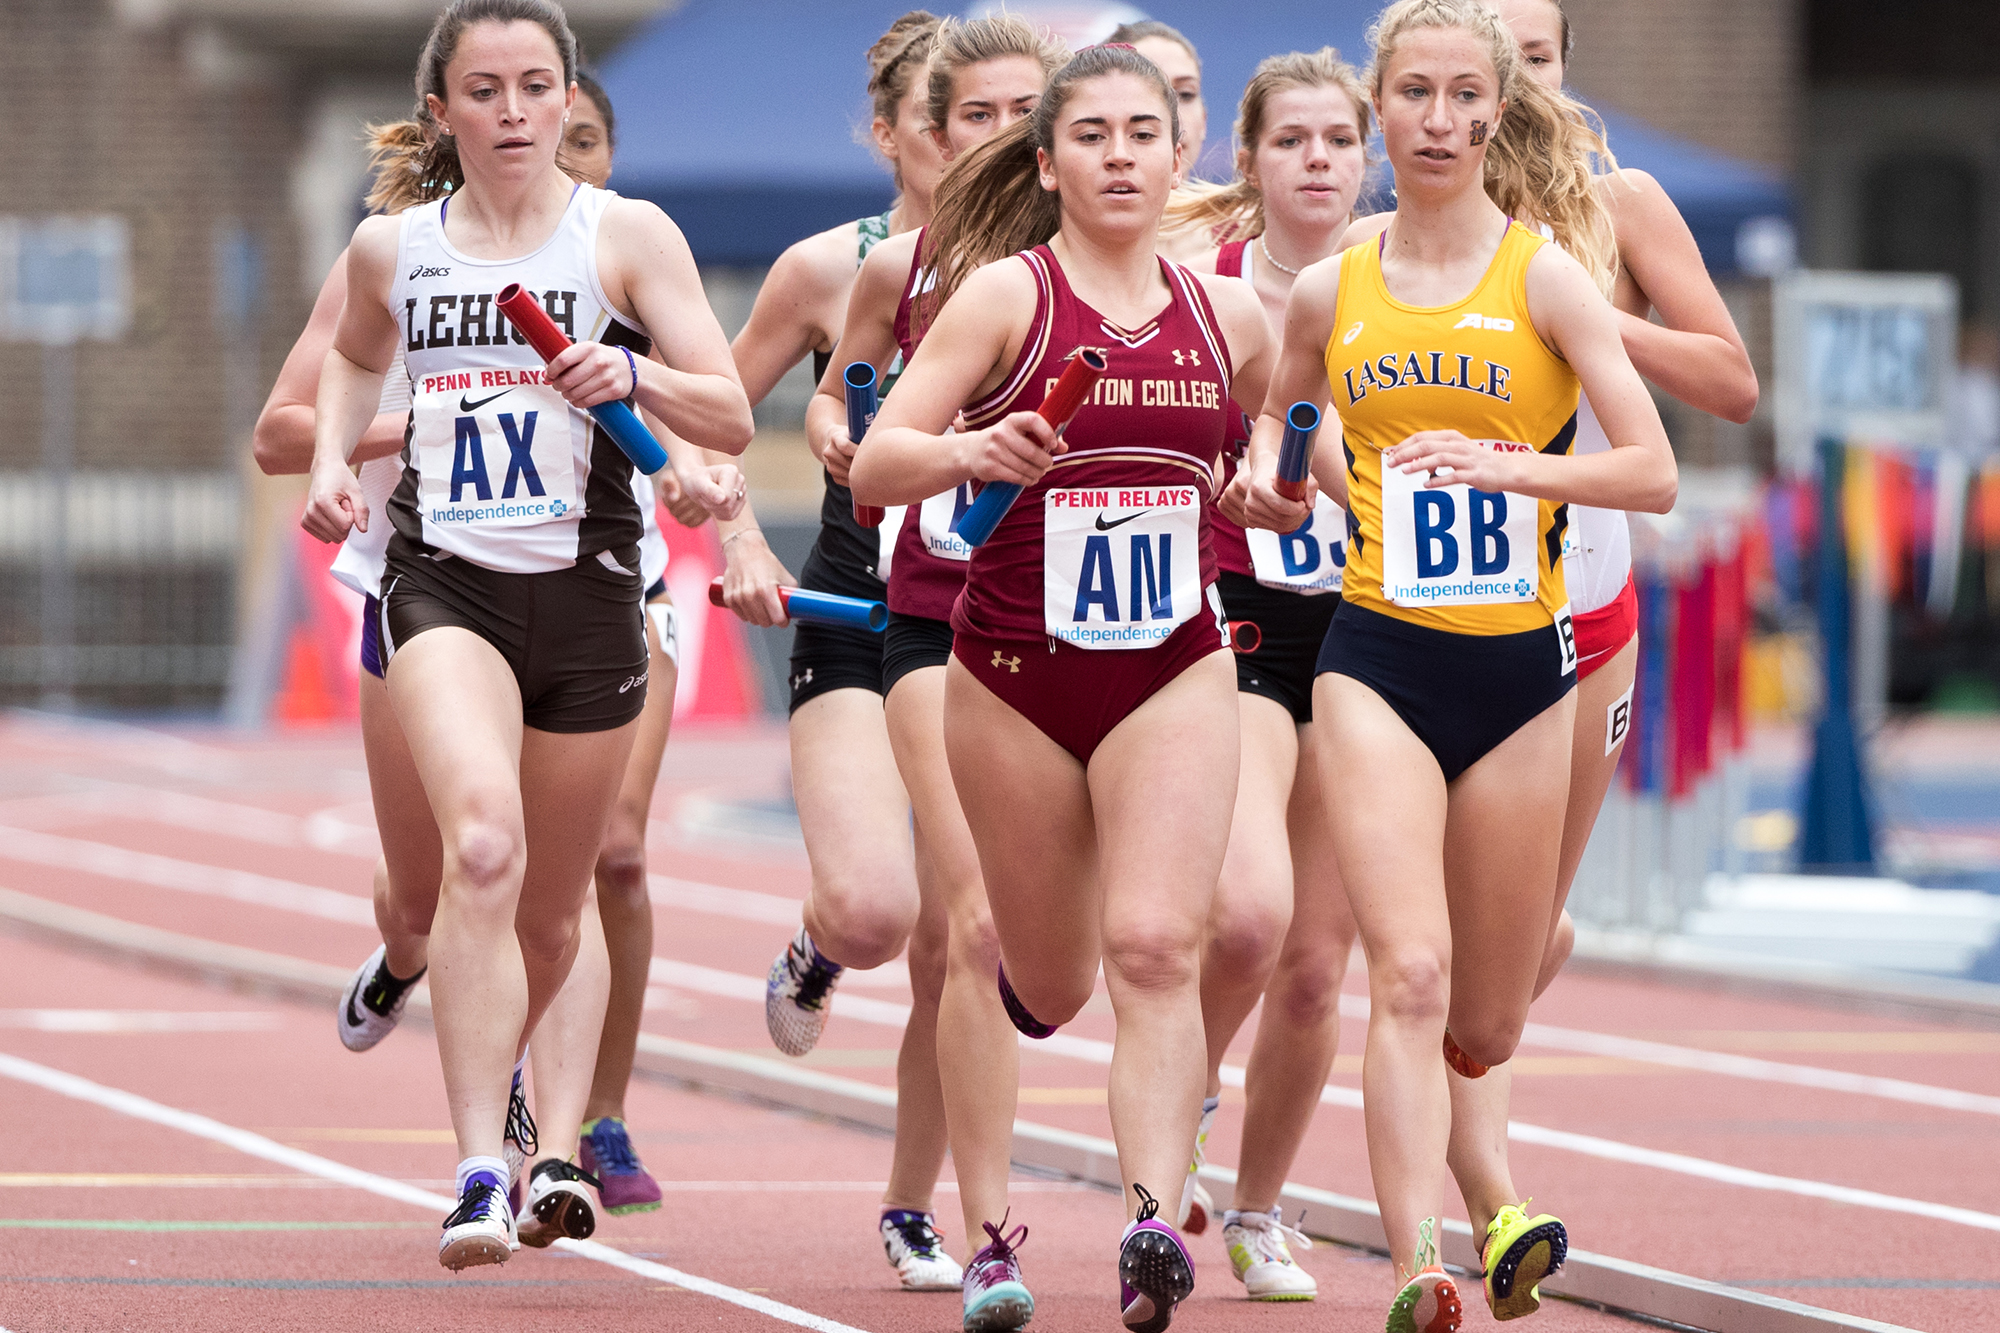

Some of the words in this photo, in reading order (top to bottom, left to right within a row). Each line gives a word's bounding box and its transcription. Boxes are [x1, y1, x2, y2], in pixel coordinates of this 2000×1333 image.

[420, 266, 451, 278] asics
[425, 372, 472, 394] PENN
[481, 370, 551, 389] RELAYS
[1142, 379, 1220, 411] COLLEGE
[449, 411, 547, 503] AX
[1054, 491, 1109, 508] PENN
[1119, 489, 1192, 507] RELAYS
[432, 502, 545, 524] Independence
[1413, 489, 1511, 579] BB
[1072, 533, 1174, 622] AN
[1394, 580, 1511, 600] Independence
[1055, 625, 1171, 645] Independence
[1611, 690, 1634, 745] B
